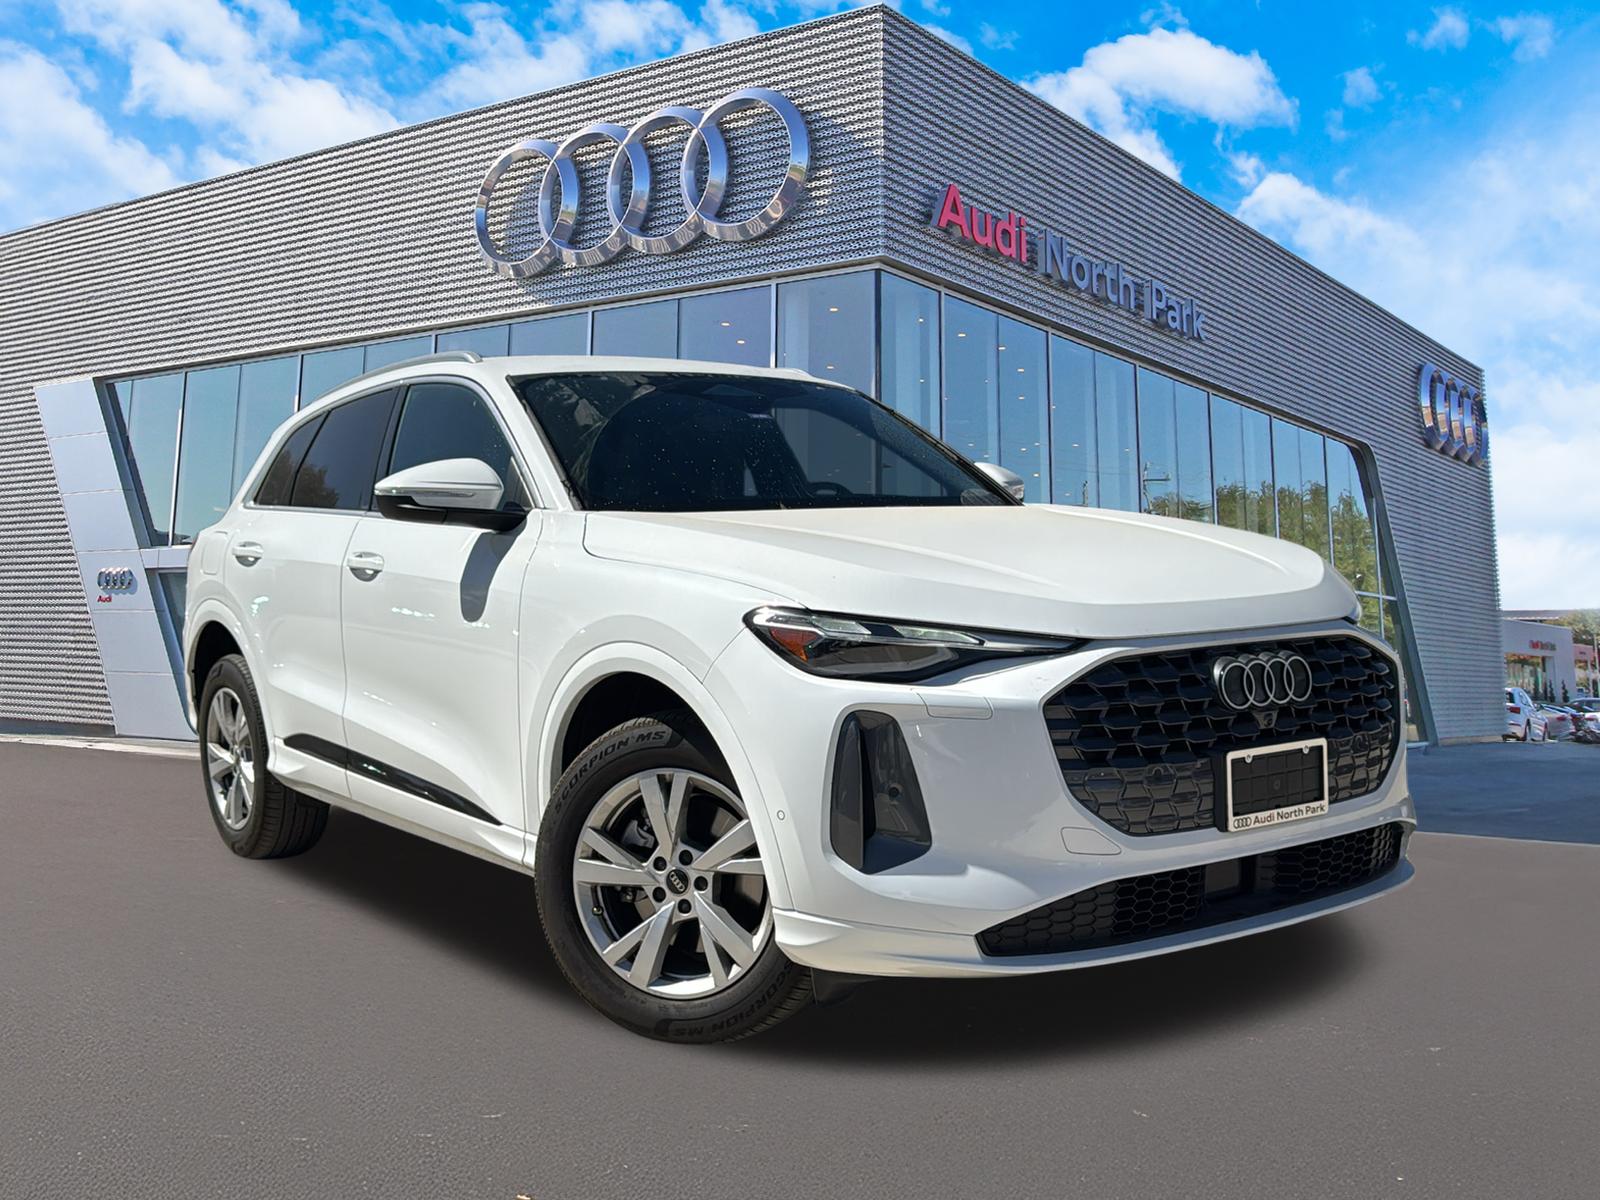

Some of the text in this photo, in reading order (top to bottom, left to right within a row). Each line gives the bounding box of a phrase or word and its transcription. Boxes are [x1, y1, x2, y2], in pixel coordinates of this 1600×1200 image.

[936, 182, 1208, 341] Audi North Park
[555, 730, 666, 812] SCORPION MS
[1252, 803, 1326, 827] Audi North Park
